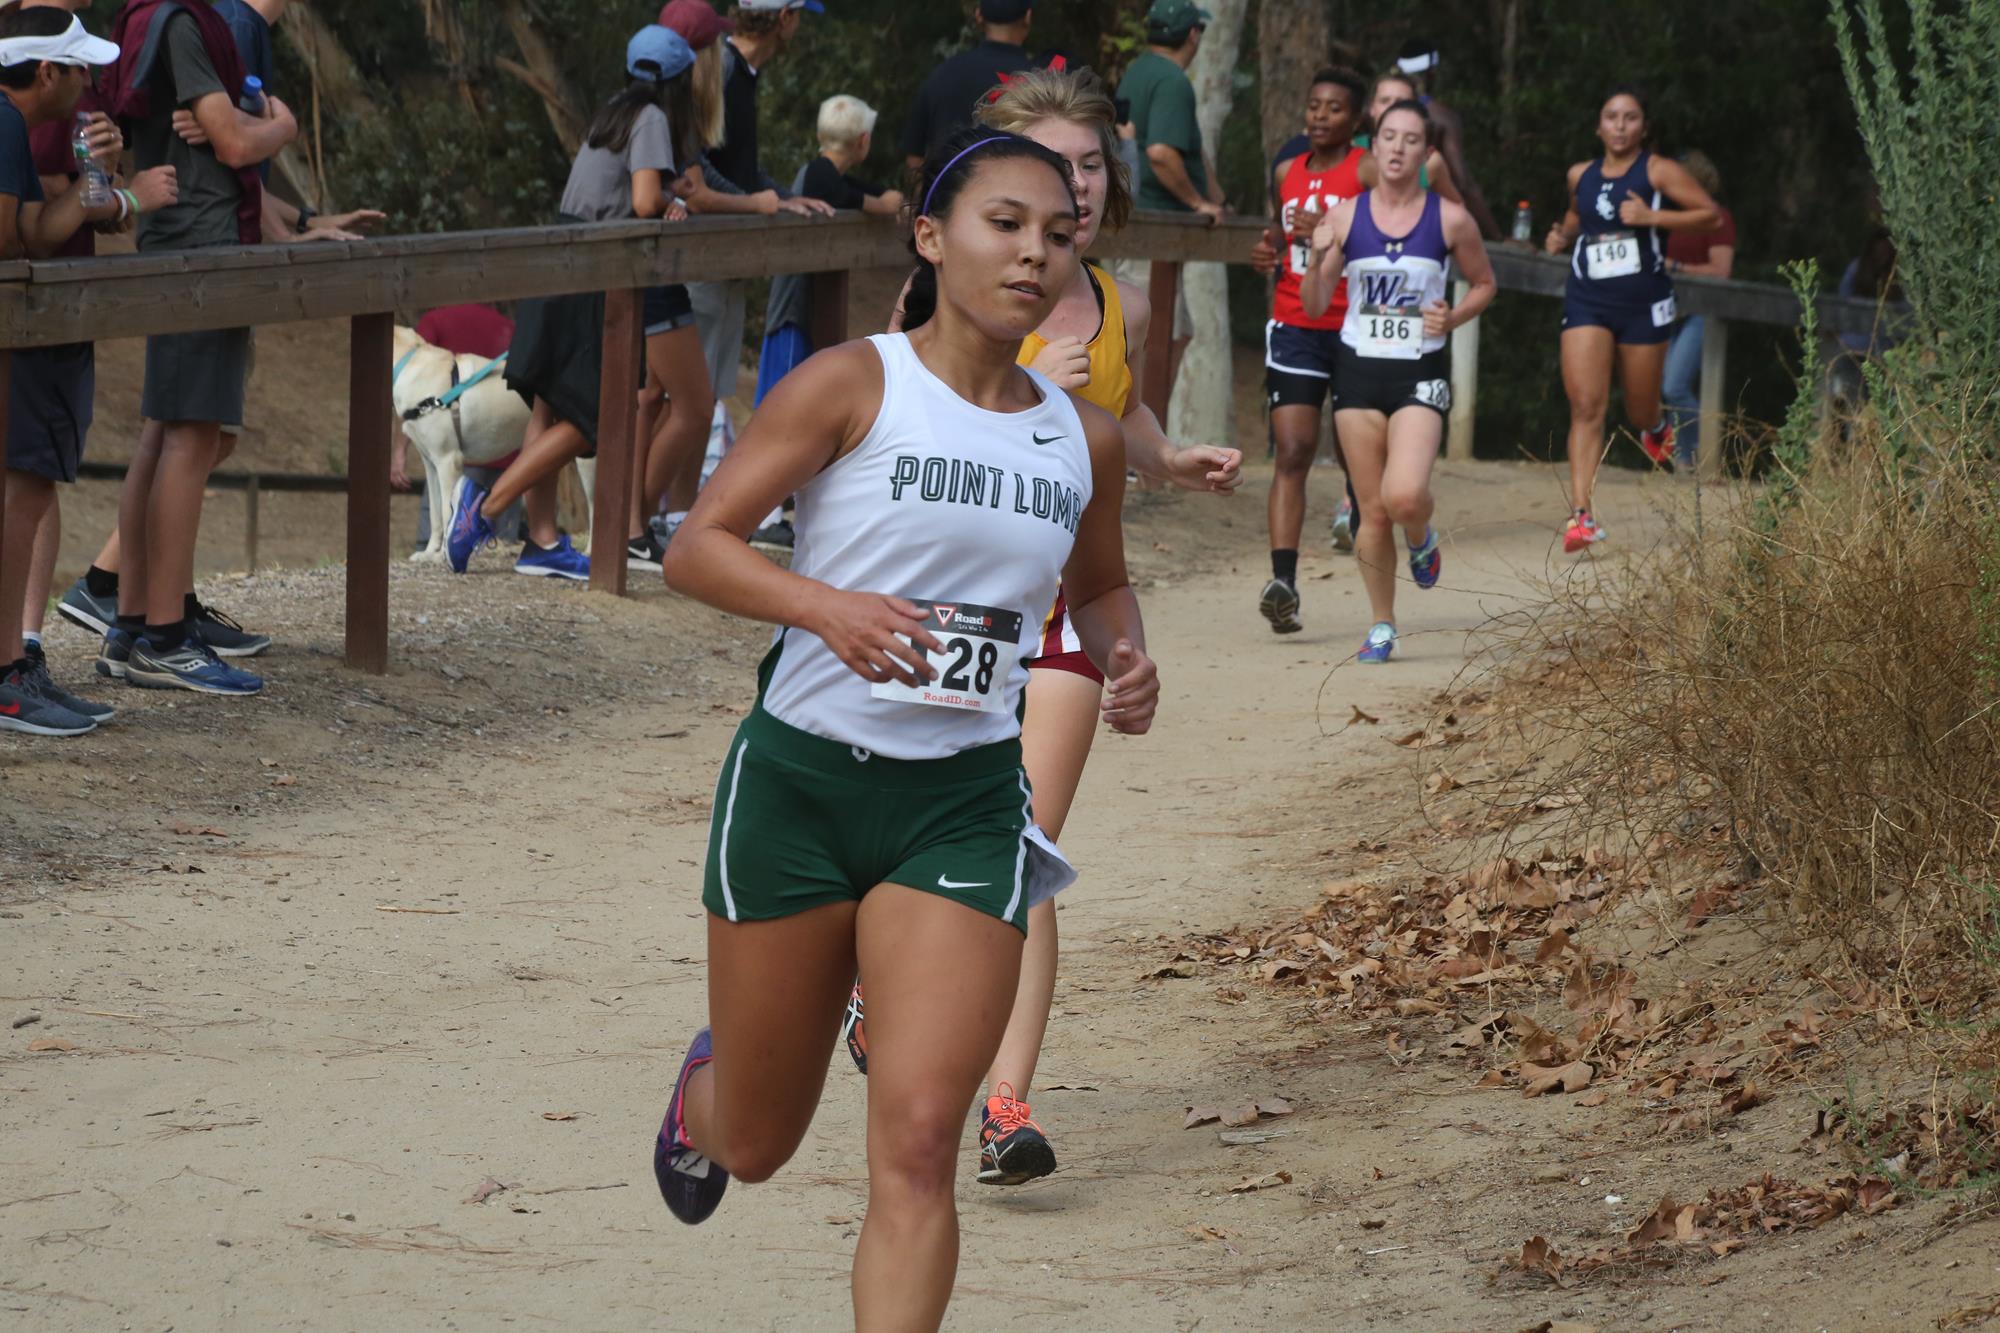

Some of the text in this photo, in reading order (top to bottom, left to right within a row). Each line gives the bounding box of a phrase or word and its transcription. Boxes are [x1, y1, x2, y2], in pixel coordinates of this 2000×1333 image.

[1596, 243, 1627, 263] 140
[1370, 318, 1410, 340] 186
[889, 455, 1004, 509] POINT
[923, 692, 982, 708] RoadID.com
